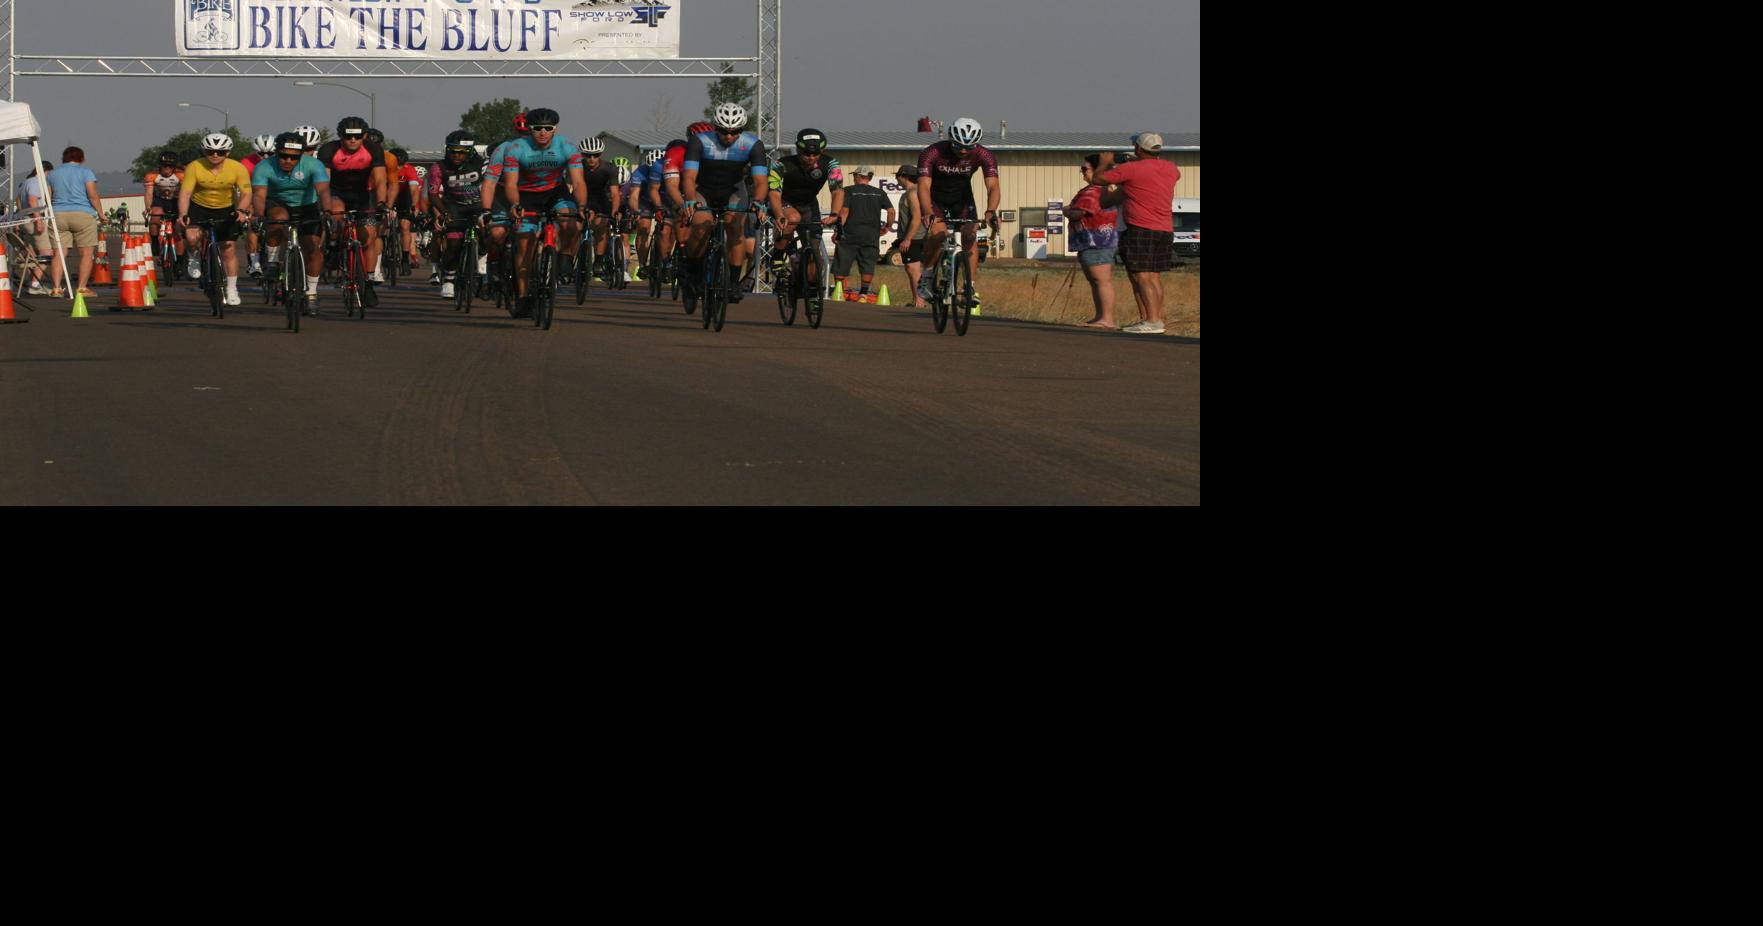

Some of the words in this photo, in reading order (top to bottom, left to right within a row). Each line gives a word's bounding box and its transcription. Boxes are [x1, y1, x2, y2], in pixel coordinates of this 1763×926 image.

[248, 6, 337, 49] BIKE
[350, 7, 428, 51] THE
[440, 8, 563, 52] BLUFF
